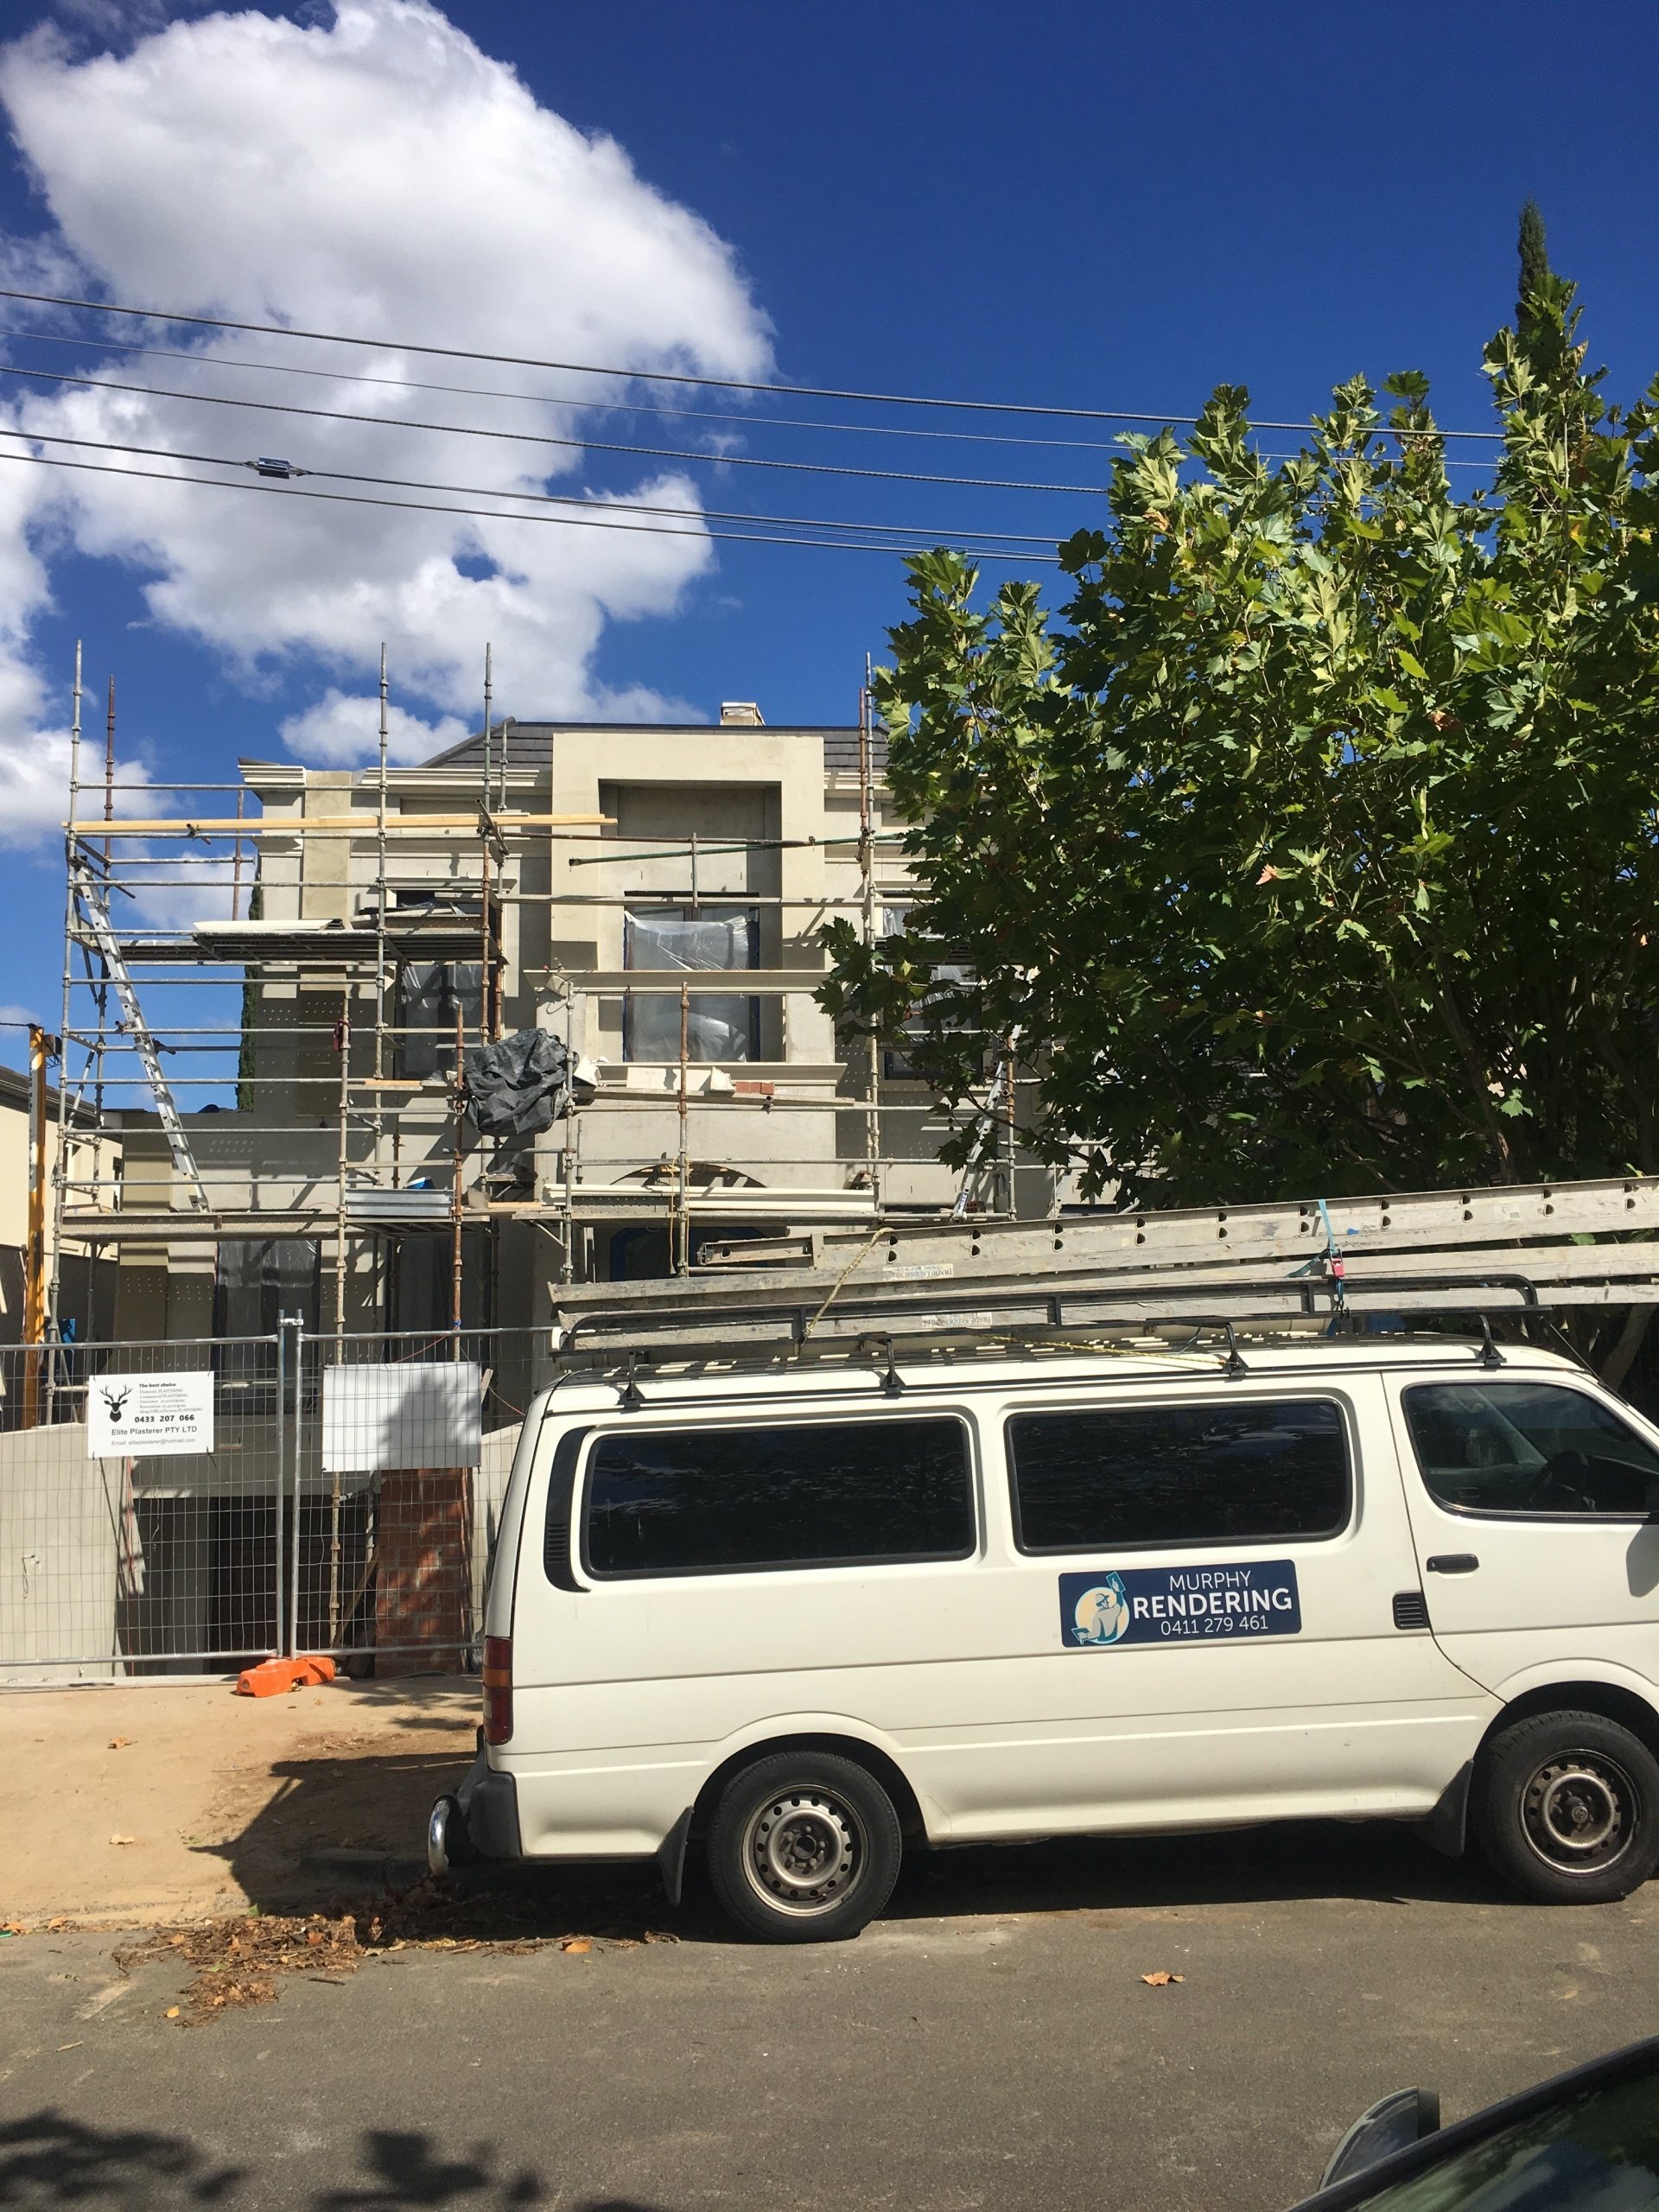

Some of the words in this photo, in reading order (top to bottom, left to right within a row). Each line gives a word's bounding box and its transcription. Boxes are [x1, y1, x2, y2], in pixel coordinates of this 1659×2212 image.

[1169, 1570, 1251, 1592] MURPHY
[1133, 1587, 1293, 1619] RENDERING
[1160, 1619, 1199, 1636] 0411
[1204, 1618, 1233, 1633] 279
[1238, 1615, 1268, 1630] 461
